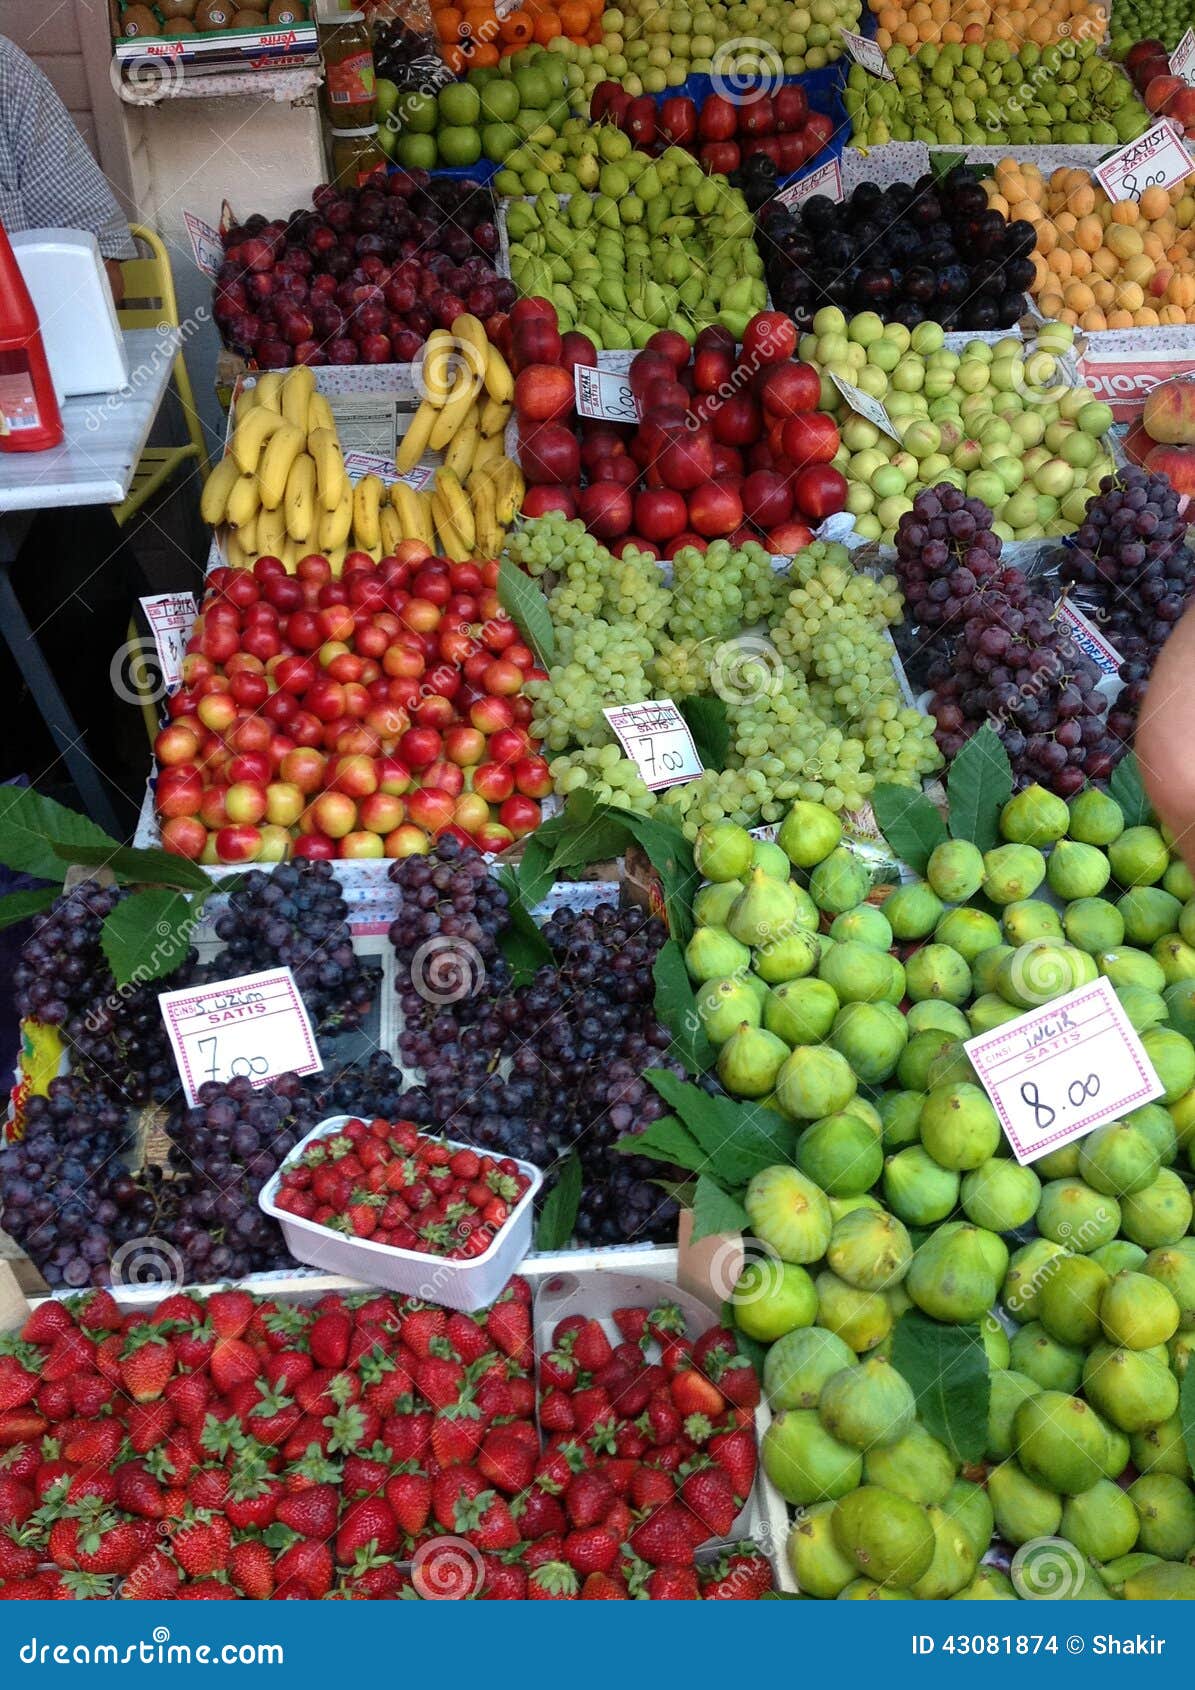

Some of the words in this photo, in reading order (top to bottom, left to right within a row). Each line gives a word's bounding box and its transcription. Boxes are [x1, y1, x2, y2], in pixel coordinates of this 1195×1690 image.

[258, 31, 297, 50] Verita
[147, 41, 184, 60] Verita
[1020, 1073, 1101, 1129] 8.00
